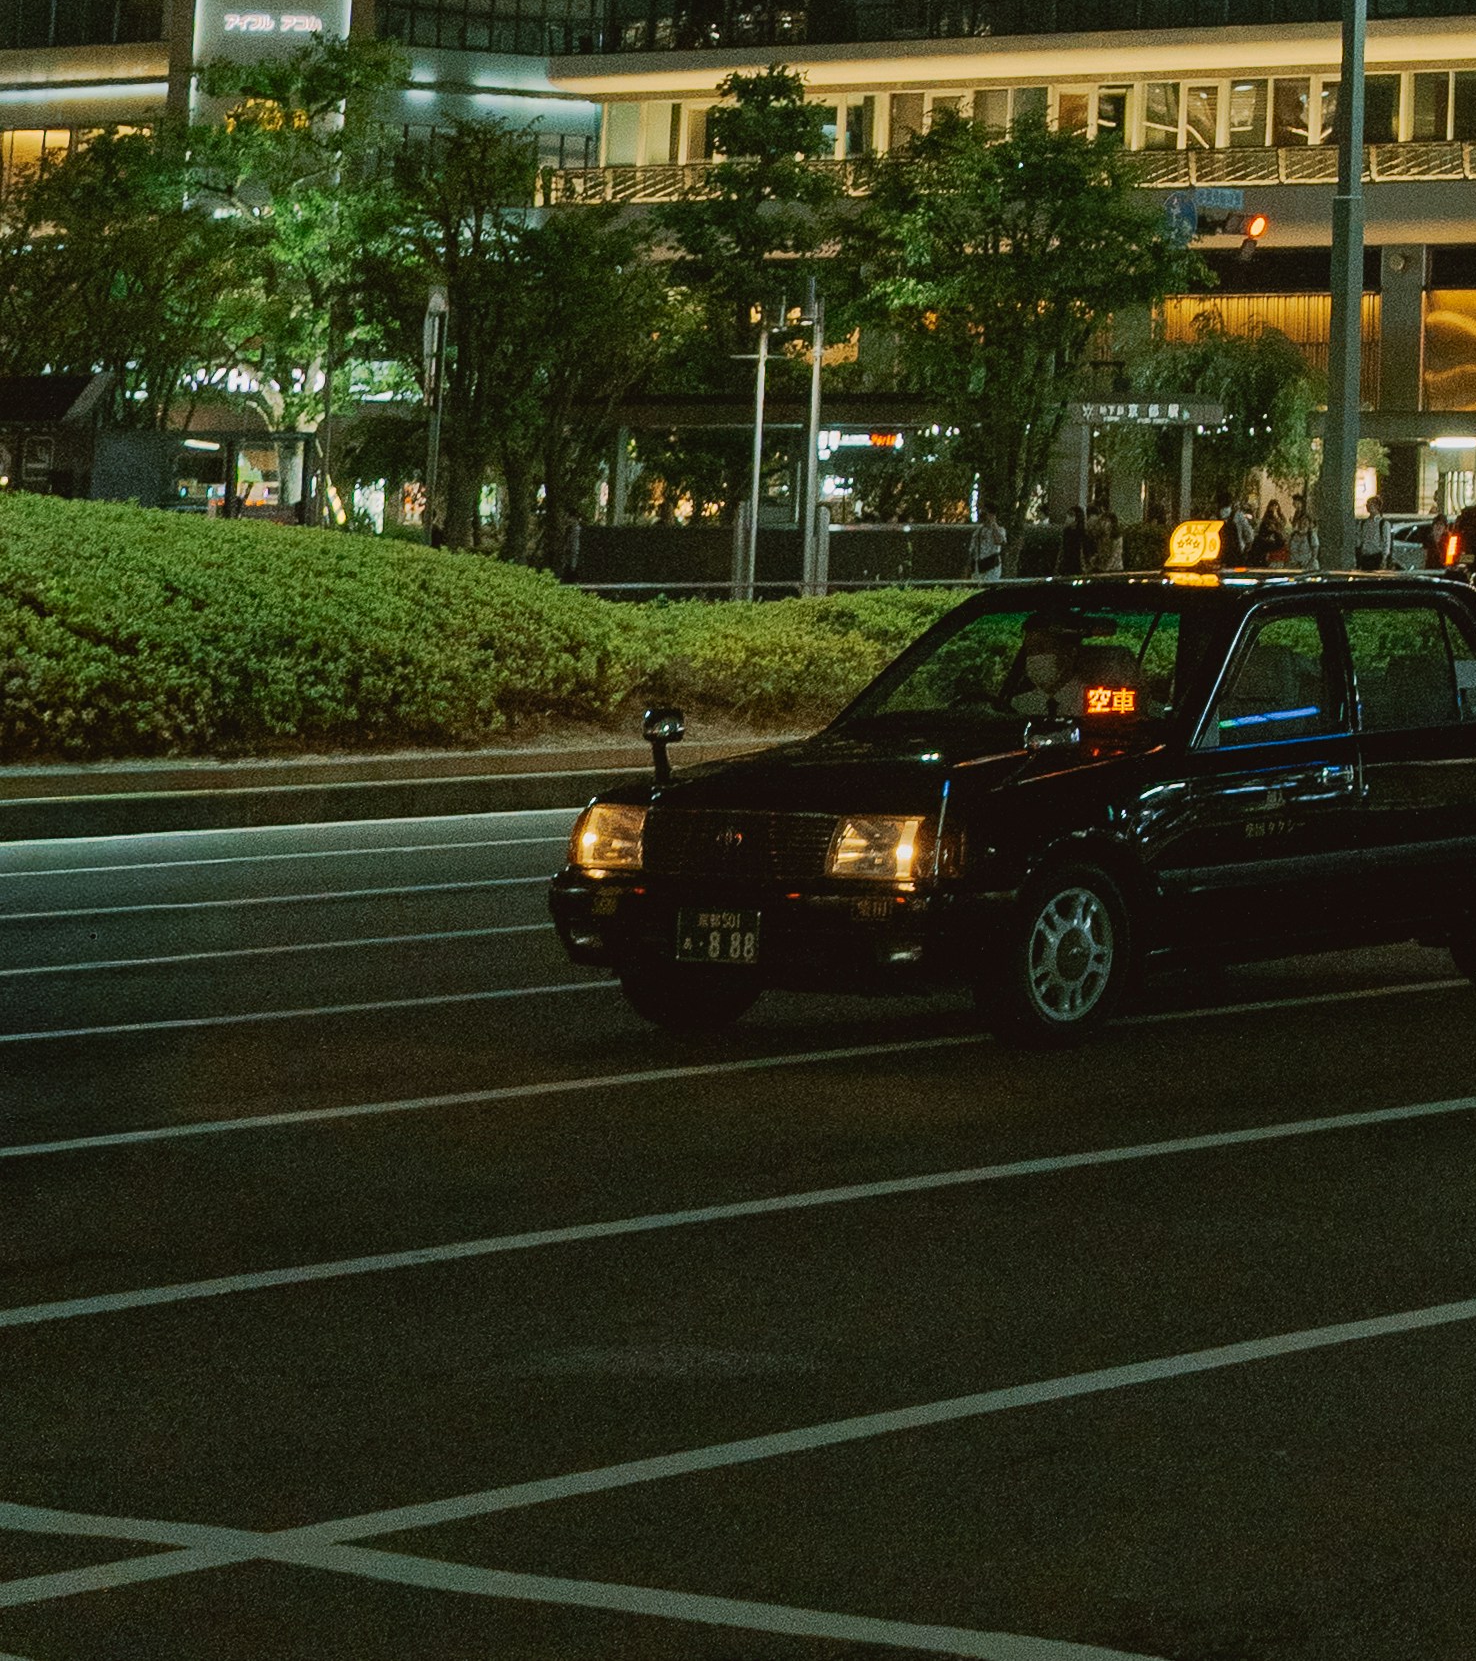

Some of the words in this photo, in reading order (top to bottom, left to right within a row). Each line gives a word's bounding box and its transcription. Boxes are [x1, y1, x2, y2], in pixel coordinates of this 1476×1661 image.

[224, 13, 276, 31] アイフル
[1087, 686, 1136, 714] 空車
